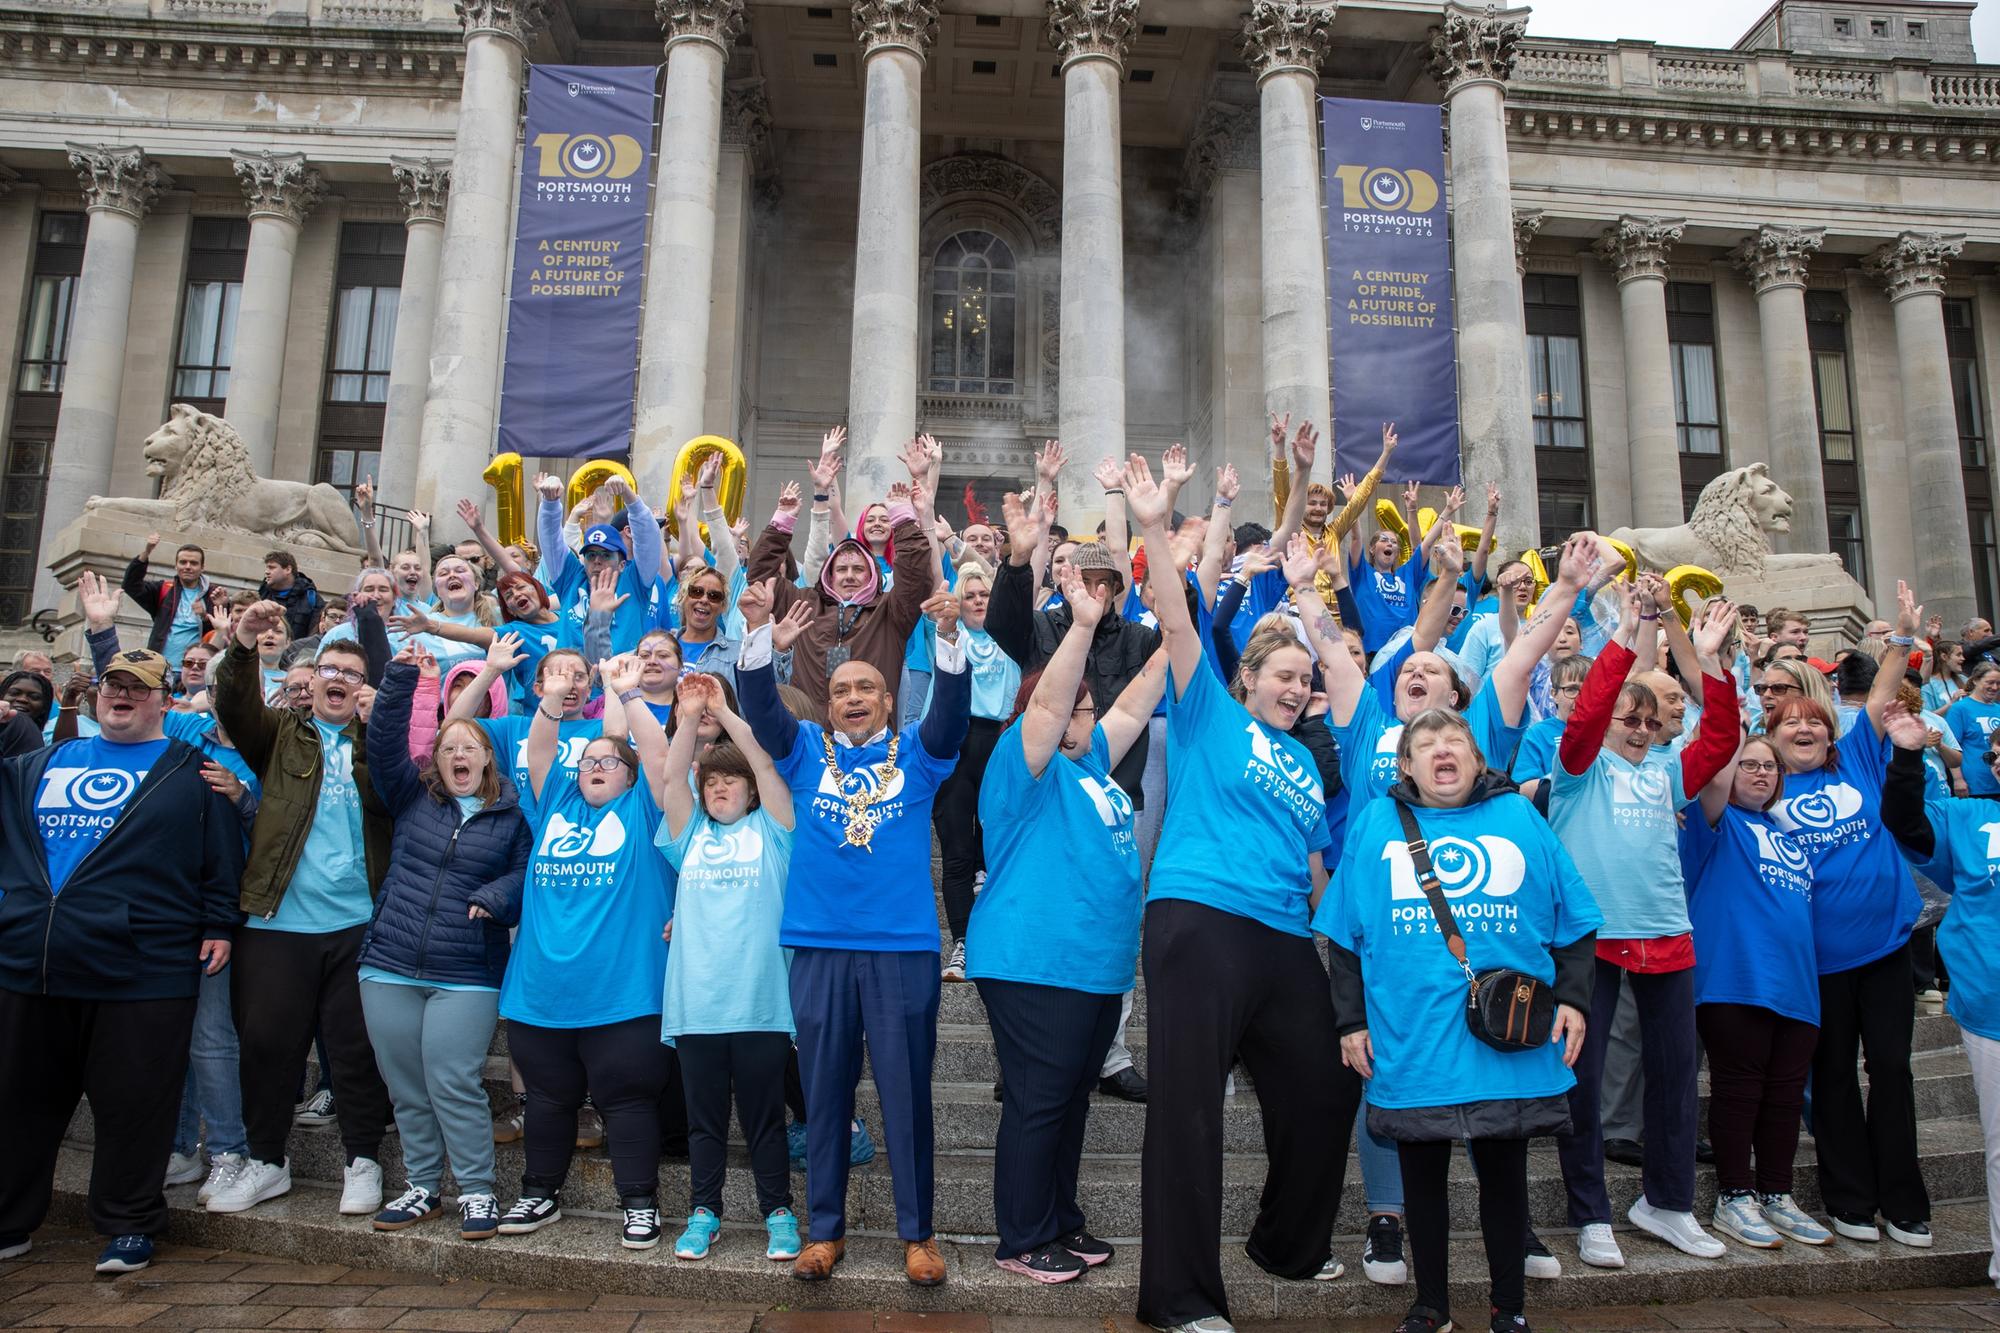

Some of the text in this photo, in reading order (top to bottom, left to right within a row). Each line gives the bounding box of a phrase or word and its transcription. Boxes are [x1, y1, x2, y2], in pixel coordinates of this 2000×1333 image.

[532, 133, 643, 179] 100
[537, 182, 631, 194] PORTSMOUTH
[1333, 165, 1439, 213] 100
[1343, 212, 1432, 227] PORTSMOUTH
[538, 240, 621, 252] A CENTURY
[543, 255, 613, 269] OF PRIDE,
[530, 270, 624, 282] A FUTURE OF
[1352, 270, 1429, 284] A CENTURY
[531, 285, 622, 297] POSSIBILITY
[1358, 285, 1425, 300] OF PRIDE,
[1348, 299, 1436, 313] A FUTURE OF
[1350, 313, 1435, 328] POSSIBILITY
[39, 814, 115, 829] PORTSMO
[1392, 903, 1518, 922] PORTMOUTH
